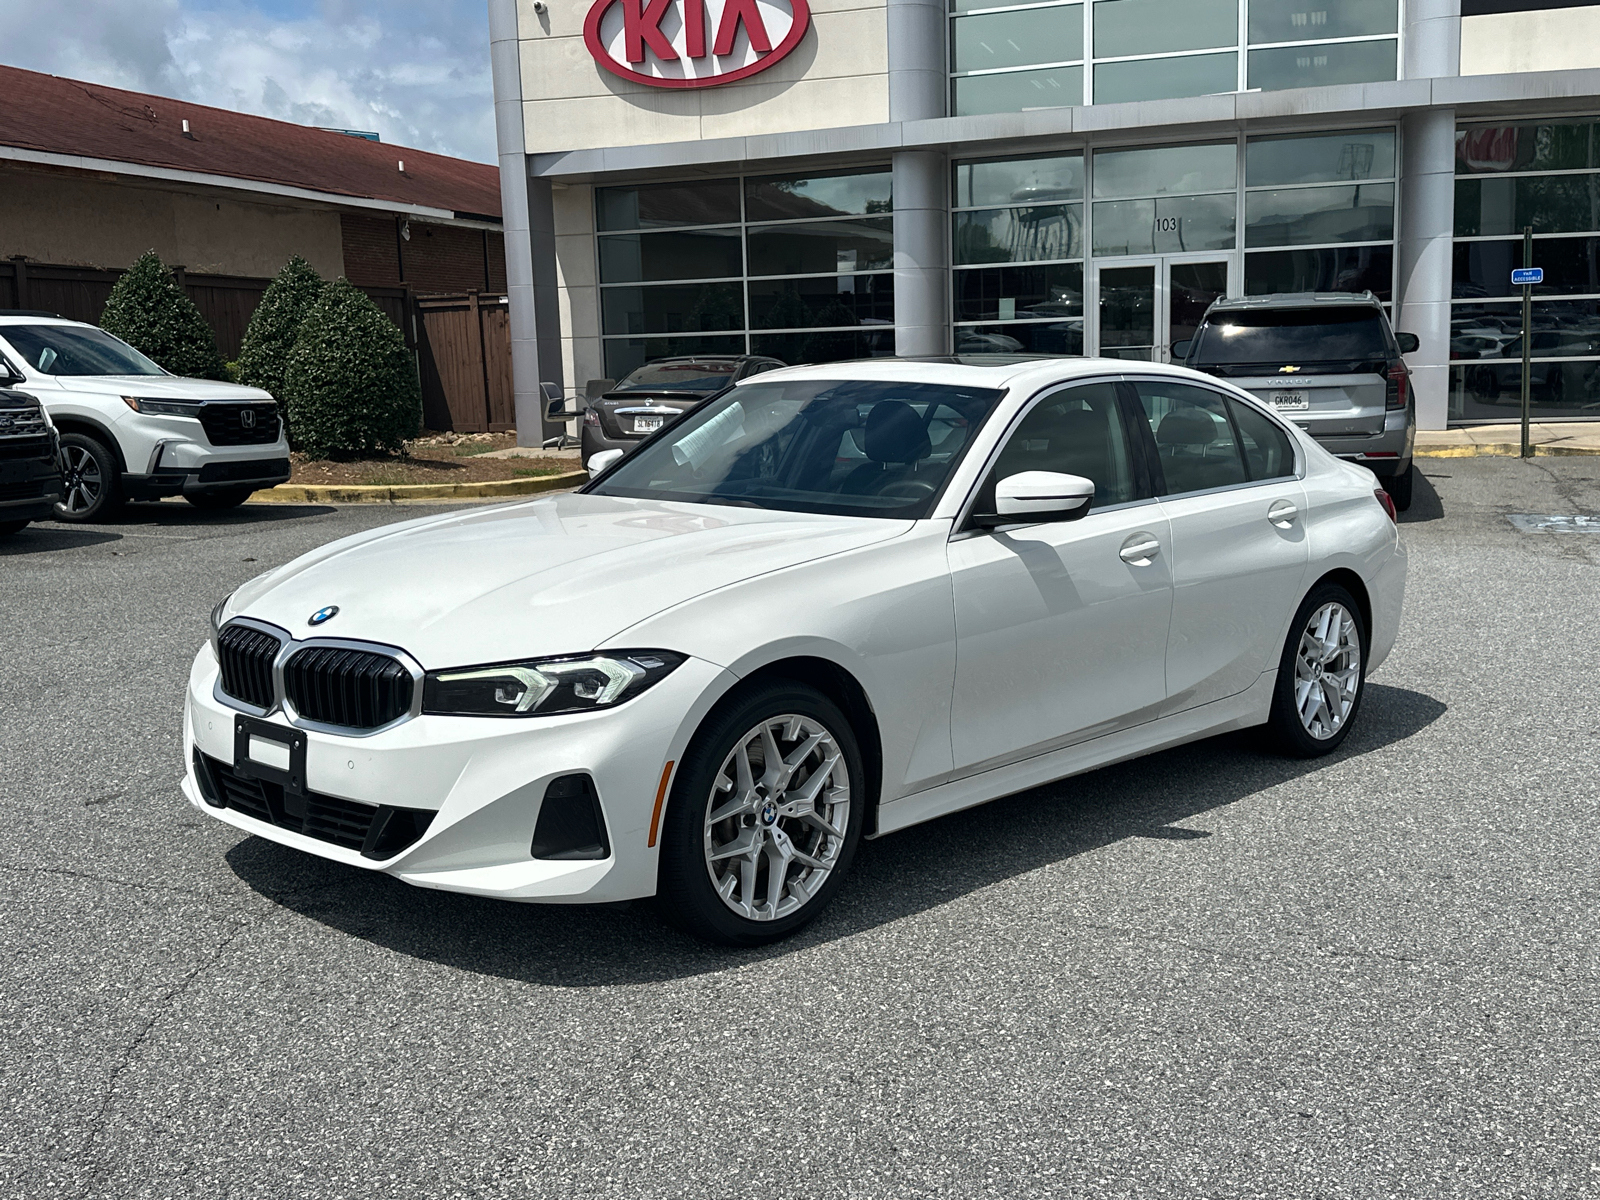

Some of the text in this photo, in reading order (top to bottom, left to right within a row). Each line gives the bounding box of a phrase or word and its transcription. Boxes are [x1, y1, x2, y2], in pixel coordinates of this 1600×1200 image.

[621, 0, 773, 62] KIA
[1157, 217, 1177, 231] 103
[1275, 395, 1302, 405] GKR046
